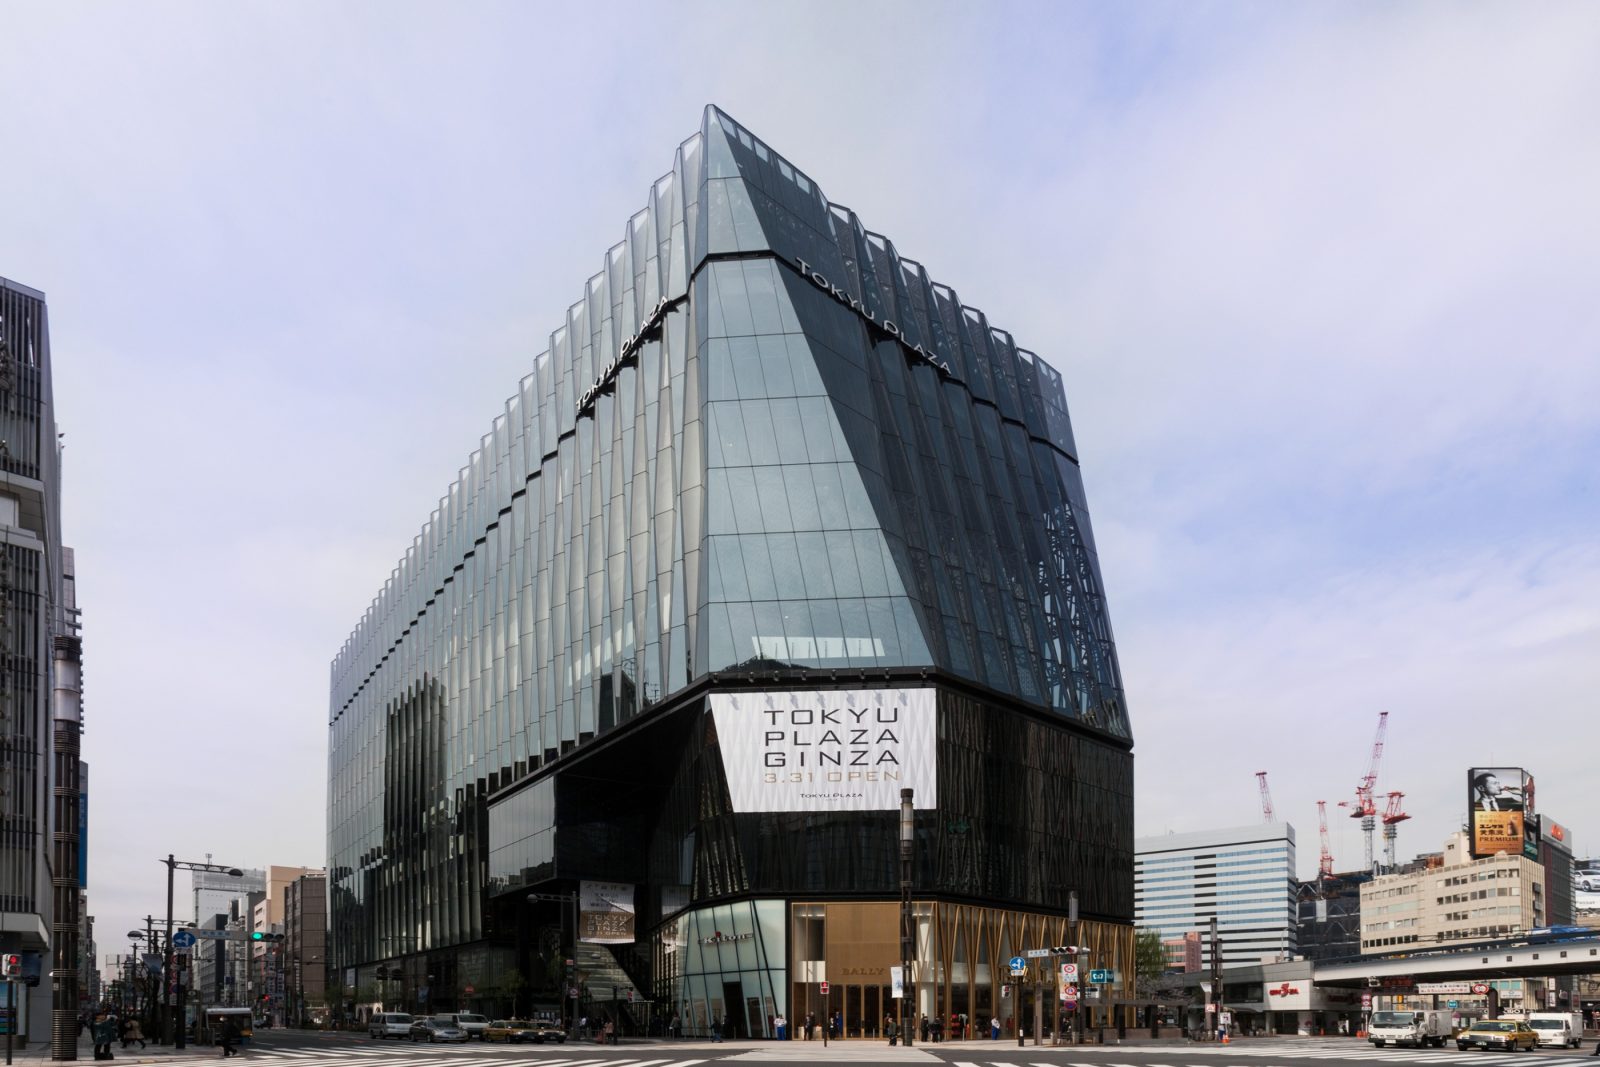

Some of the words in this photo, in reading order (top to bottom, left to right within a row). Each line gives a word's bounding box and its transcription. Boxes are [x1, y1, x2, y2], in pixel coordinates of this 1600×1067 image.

[795, 257, 874, 320] TOKYU
[883, 319, 952, 375] PLAZA
[763, 707, 899, 725] TOKYU
[764, 728, 899, 747] PLAZA
[764, 750, 900, 767] GINZA
[764, 772, 814, 784] 3.31
[827, 771, 900, 783] OPEN
[841, 967, 885, 976] BALLY
